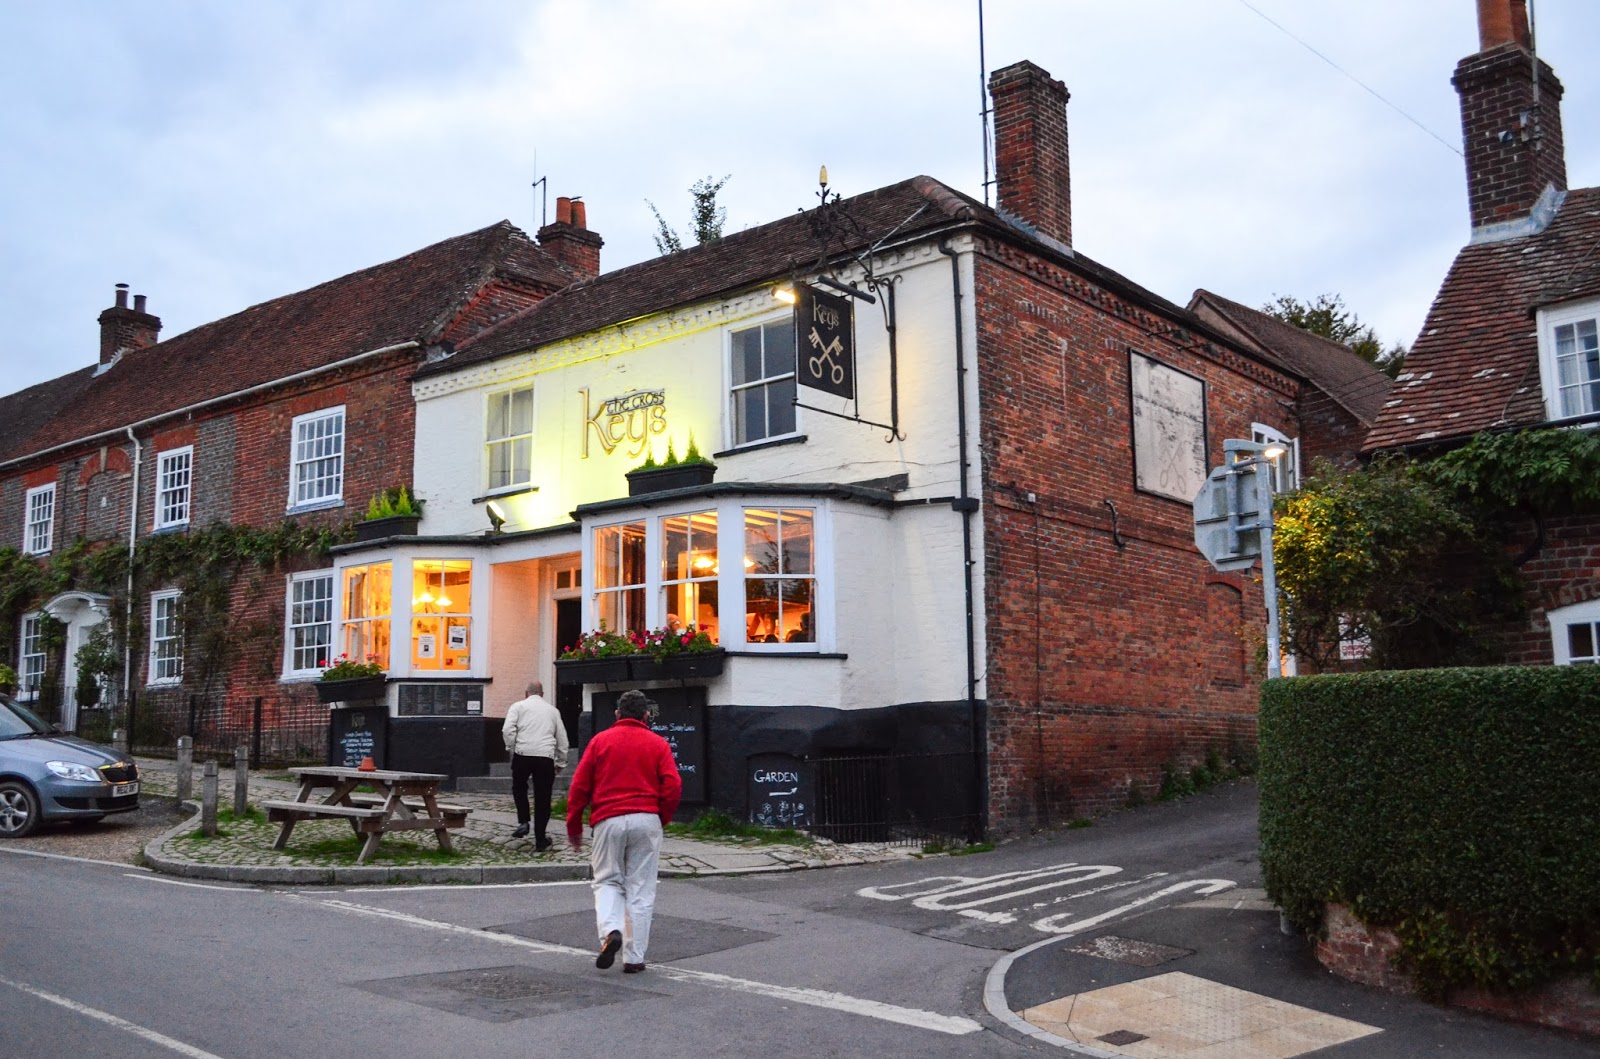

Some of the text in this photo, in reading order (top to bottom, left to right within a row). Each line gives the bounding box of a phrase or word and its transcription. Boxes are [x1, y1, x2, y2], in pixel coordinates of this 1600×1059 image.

[812, 295, 840, 331] Keys
[577, 387, 667, 459] Keys
[753, 769, 799, 783] GARDEN
